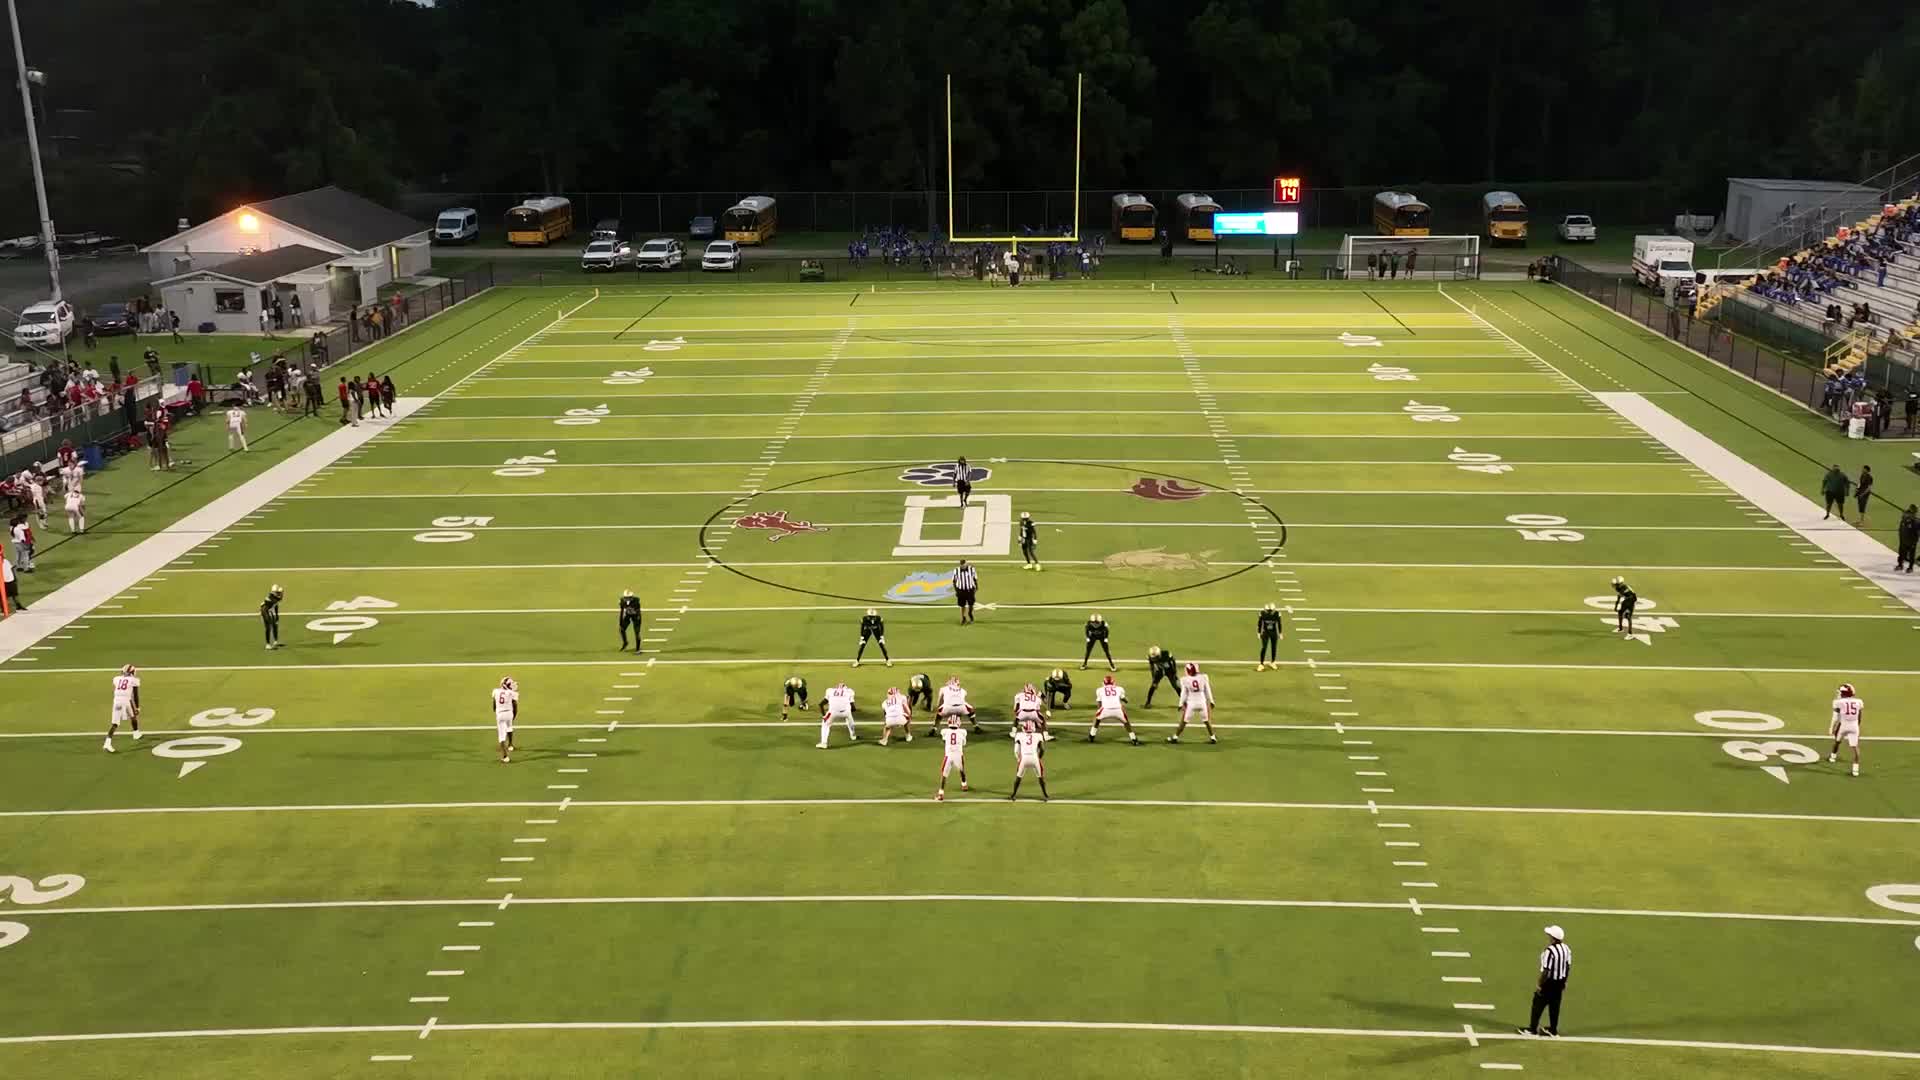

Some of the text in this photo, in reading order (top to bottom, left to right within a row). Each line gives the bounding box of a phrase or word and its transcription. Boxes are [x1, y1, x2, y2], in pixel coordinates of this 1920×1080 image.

[1282, 188, 1297, 200] 14
[553, 408, 611, 426] 30
[492, 455, 559, 477] 40
[1447, 453, 1515, 474] 40
[413, 516, 495, 543] 50
[1505, 513, 1585, 543] 50
[305, 595, 399, 633] 40
[117, 679, 129, 691] 18
[1104, 686, 1118, 697] 65
[1192, 679, 1200, 693] 9
[499, 691, 506, 705] 6
[1845, 702, 1858, 716] 15
[151, 706, 276, 759] 30
[949, 732, 957, 746] 8
[1025, 734, 1033, 746] 3
[1694, 708, 1821, 765] 30
[0, 873, 86, 949] 2
